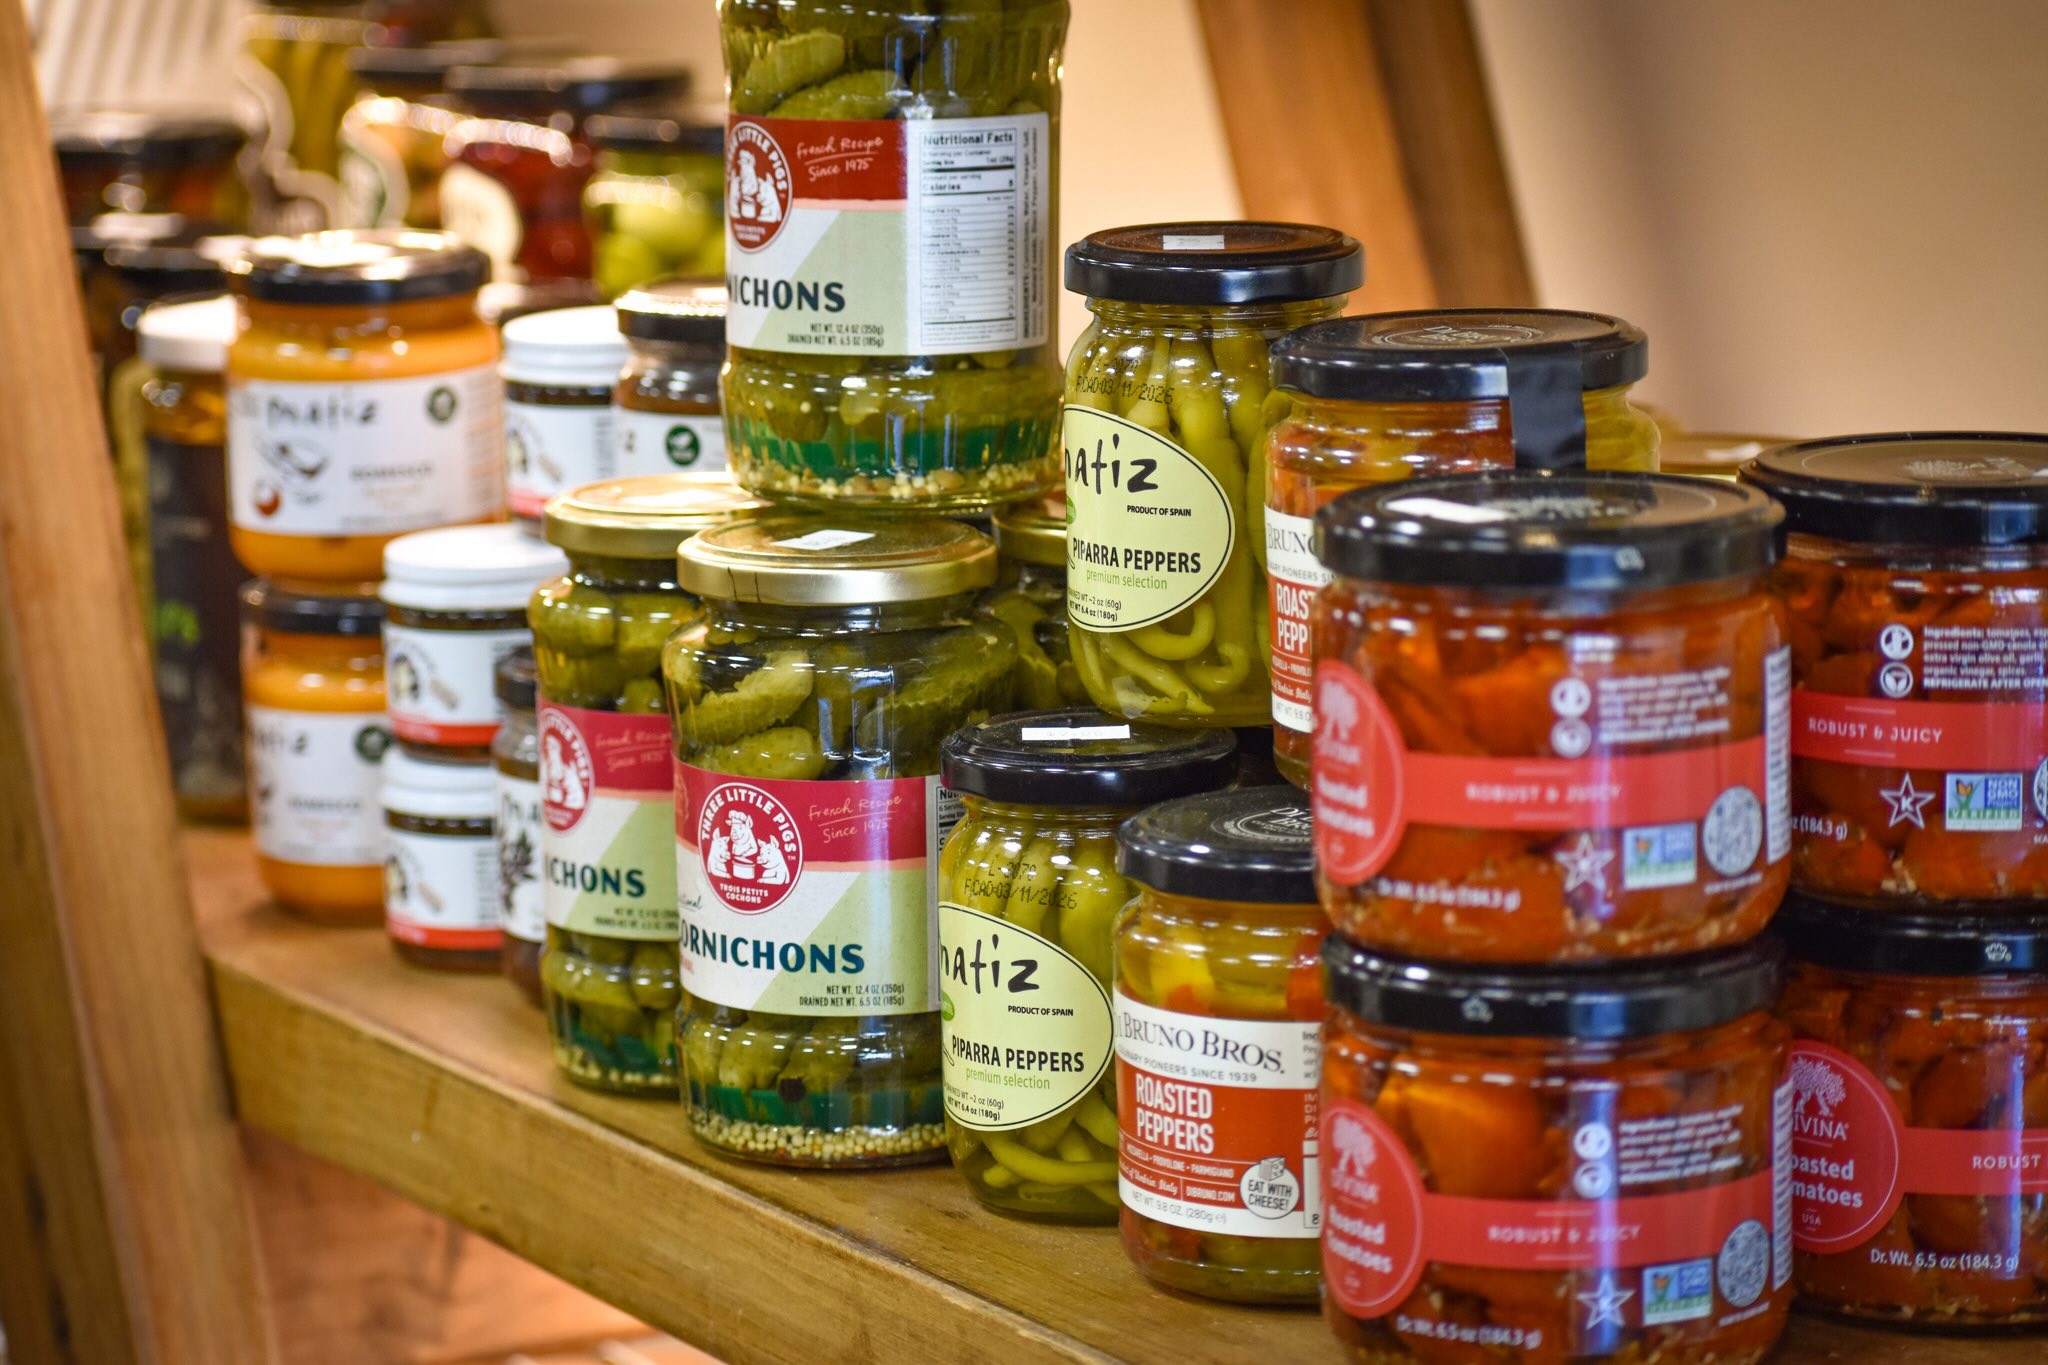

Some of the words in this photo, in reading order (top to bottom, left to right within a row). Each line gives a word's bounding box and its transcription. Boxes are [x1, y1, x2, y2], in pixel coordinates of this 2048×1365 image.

[796, 136, 837, 159] French
[924, 133, 984, 145] Nutritional
[987, 133, 1014, 144] Facts
[768, 150, 788, 191] PIGS
[808, 163, 841, 182] Since
[845, 158, 873, 173] 1975
[923, 183, 961, 191] Calories
[810, 324, 822, 332] NET
[1127, 505, 1157, 516] PRODUCT
[1159, 507, 1168, 516] OF
[1170, 508, 1191, 517] SPAIN
[1073, 537, 1119, 568] PIPARRA
[1124, 548, 1201, 574] PEPPERS
[1086, 568, 1120, 586] premium
[1122, 573, 1168, 590] selection
[1282, 566, 1318, 581] PIONEERS
[1097, 599, 1104, 607] oz
[1105, 598, 1121, 611] (60g)
[1090, 609, 1096, 617] oz
[1097, 609, 1118, 622] (180g)
[1277, 617, 1313, 654] PEPP
[1978, 653, 2000, 663] olive
[1924, 678, 1989, 689] REFRIGERATE
[1991, 678, 2021, 689] AFTER
[1808, 717, 1867, 739] ROBUST
[1873, 726, 1884, 740] &
[1890, 727, 1943, 744] JUICY
[1466, 784, 1540, 803] ROBUST
[1566, 784, 1621, 801] JUICY
[1988, 779, 2018, 789] NON
[1988, 789, 2018, 799] GMO
[808, 798, 853, 822] French
[858, 794, 903, 813] Recipe
[1951, 810, 2017, 819] VERIFIED
[702, 794, 725, 840] THREE
[725, 788, 775, 815] LITTLE
[773, 812, 797, 853] PIGS
[1800, 815, 1833, 836] (184.3
[1835, 821, 1848, 842] g)
[822, 825, 858, 844] Since
[863, 817, 893, 833] 1975
[720, 883, 740, 893] TROIS
[742, 887, 769, 898] PETITS
[725, 892, 762, 905] COCHONS
[826, 985, 839, 995] NET
[841, 985, 853, 995] WT.
[856, 985, 869, 995] 12.4
[871, 985, 880, 994] OZ
[881, 983, 905, 995] (350g)
[799, 996, 829, 1007] DRAINED
[830, 996, 844, 1007] NET
[845, 996, 857, 1007] WT.
[859, 996, 871, 1007] 6.5
[872, 996, 881, 1006] OZ
[883, 995, 905, 1007] (185g)
[1008, 1005, 1039, 1016] PRODUCT
[1040, 1007, 1050, 1016] OF
[1052, 1008, 1074, 1017] SPAIN
[1123, 1011, 1195, 1052] BRUNO
[1202, 1029, 1286, 1075] BROS.
[952, 1035, 1001, 1067] PIPARRA
[1006, 1048, 1085, 1073] PEPPERS
[966, 1067, 1001, 1086] premium
[1003, 1073, 1051, 1090] selection
[1144, 1056, 1187, 1076] PIONEERS
[1191, 1068, 1225, 1081] SINCE
[1229, 1072, 1257, 1083] 1939
[987, 1097, 1004, 1110] (60g)
[1135, 1073, 1213, 1120] ROASTED
[954, 1100, 961, 1109] WT
[961, 1104, 969, 1112] 6.4
[979, 1108, 1001, 1122] (180g)
[1136, 1107, 1215, 1155] PEPPERS
[1972, 1155, 2041, 1170] ROBUST
[1248, 1179, 1264, 1192] EAT
[1267, 1183, 1293, 1198] WITH
[1248, 1194, 1290, 1212] CHEESE!
[1802, 1213, 1822, 1226] USA
[1488, 1224, 1561, 1243] ROBUST
[1586, 1224, 1641, 1242] JUICY
[1870, 1248, 1888, 1264] Dr.
[1889, 1250, 1912, 1267] Wt.
[1915, 1253, 1936, 1269] 6.5
[1940, 1256, 1955, 1269] oz
[1960, 1254, 2003, 1272] (184.3
[2005, 1255, 2019, 1273] g)
